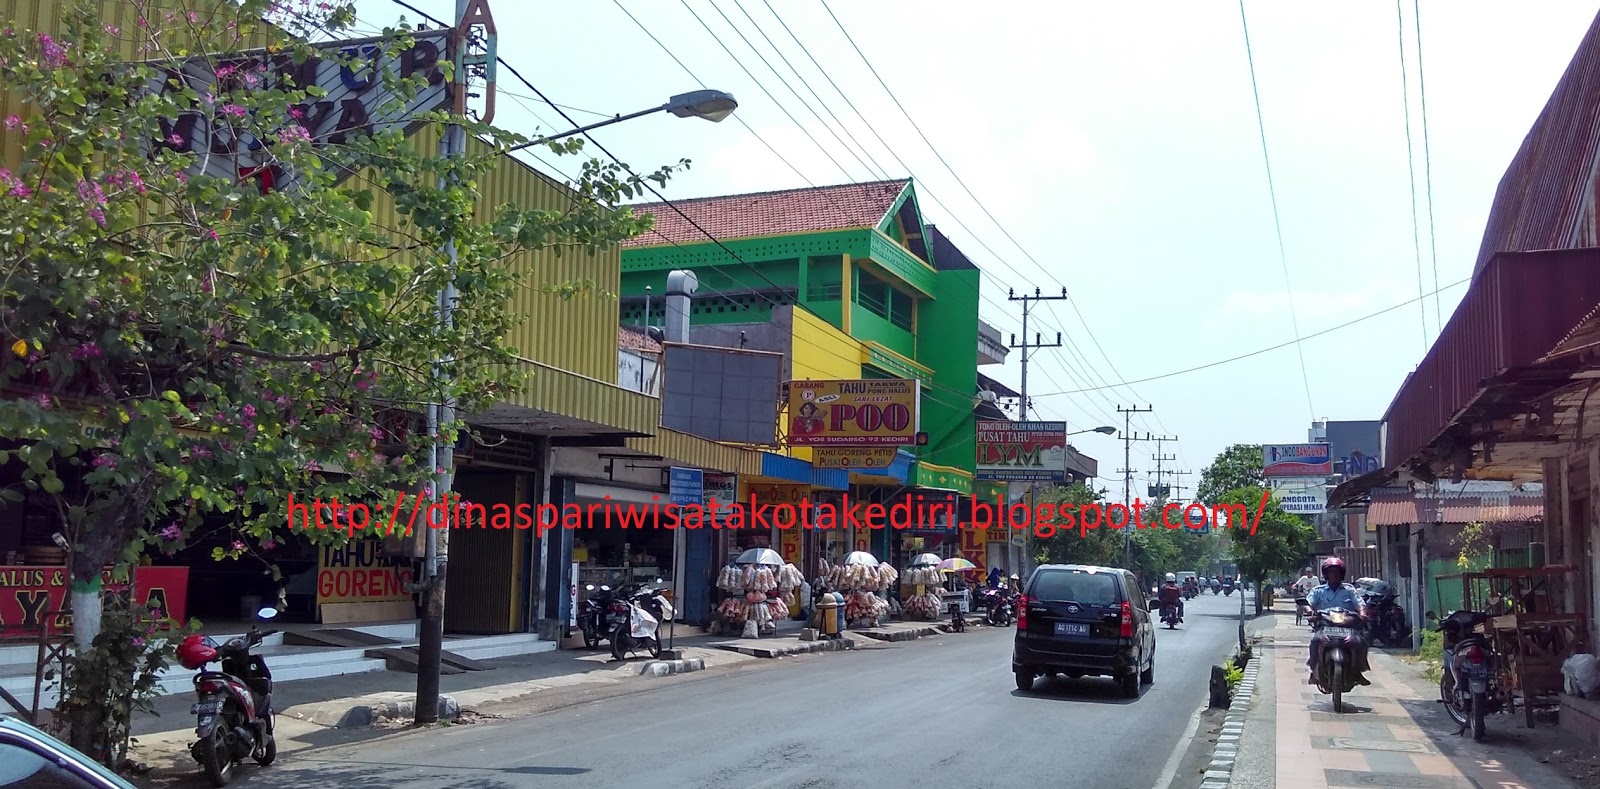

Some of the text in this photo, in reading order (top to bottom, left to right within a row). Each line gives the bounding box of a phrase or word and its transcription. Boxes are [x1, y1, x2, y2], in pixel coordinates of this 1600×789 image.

[838, 382, 867, 394] TAHU
[818, 394, 837, 403] ASLI
[828, 403, 910, 432] POO
[979, 422, 995, 431] TOKO
[995, 422, 1027, 431] OLEH-OLEH
[1027, 422, 1044, 431] KHAS
[978, 431, 1031, 443] PUSAT TAHU
[976, 443, 1044, 468] LYM
[1281, 446, 1328, 458] INDOBANGUNAN
[1279, 503, 1324, 511] OPERASI MEKAR
[318, 569, 413, 598] GORENG
